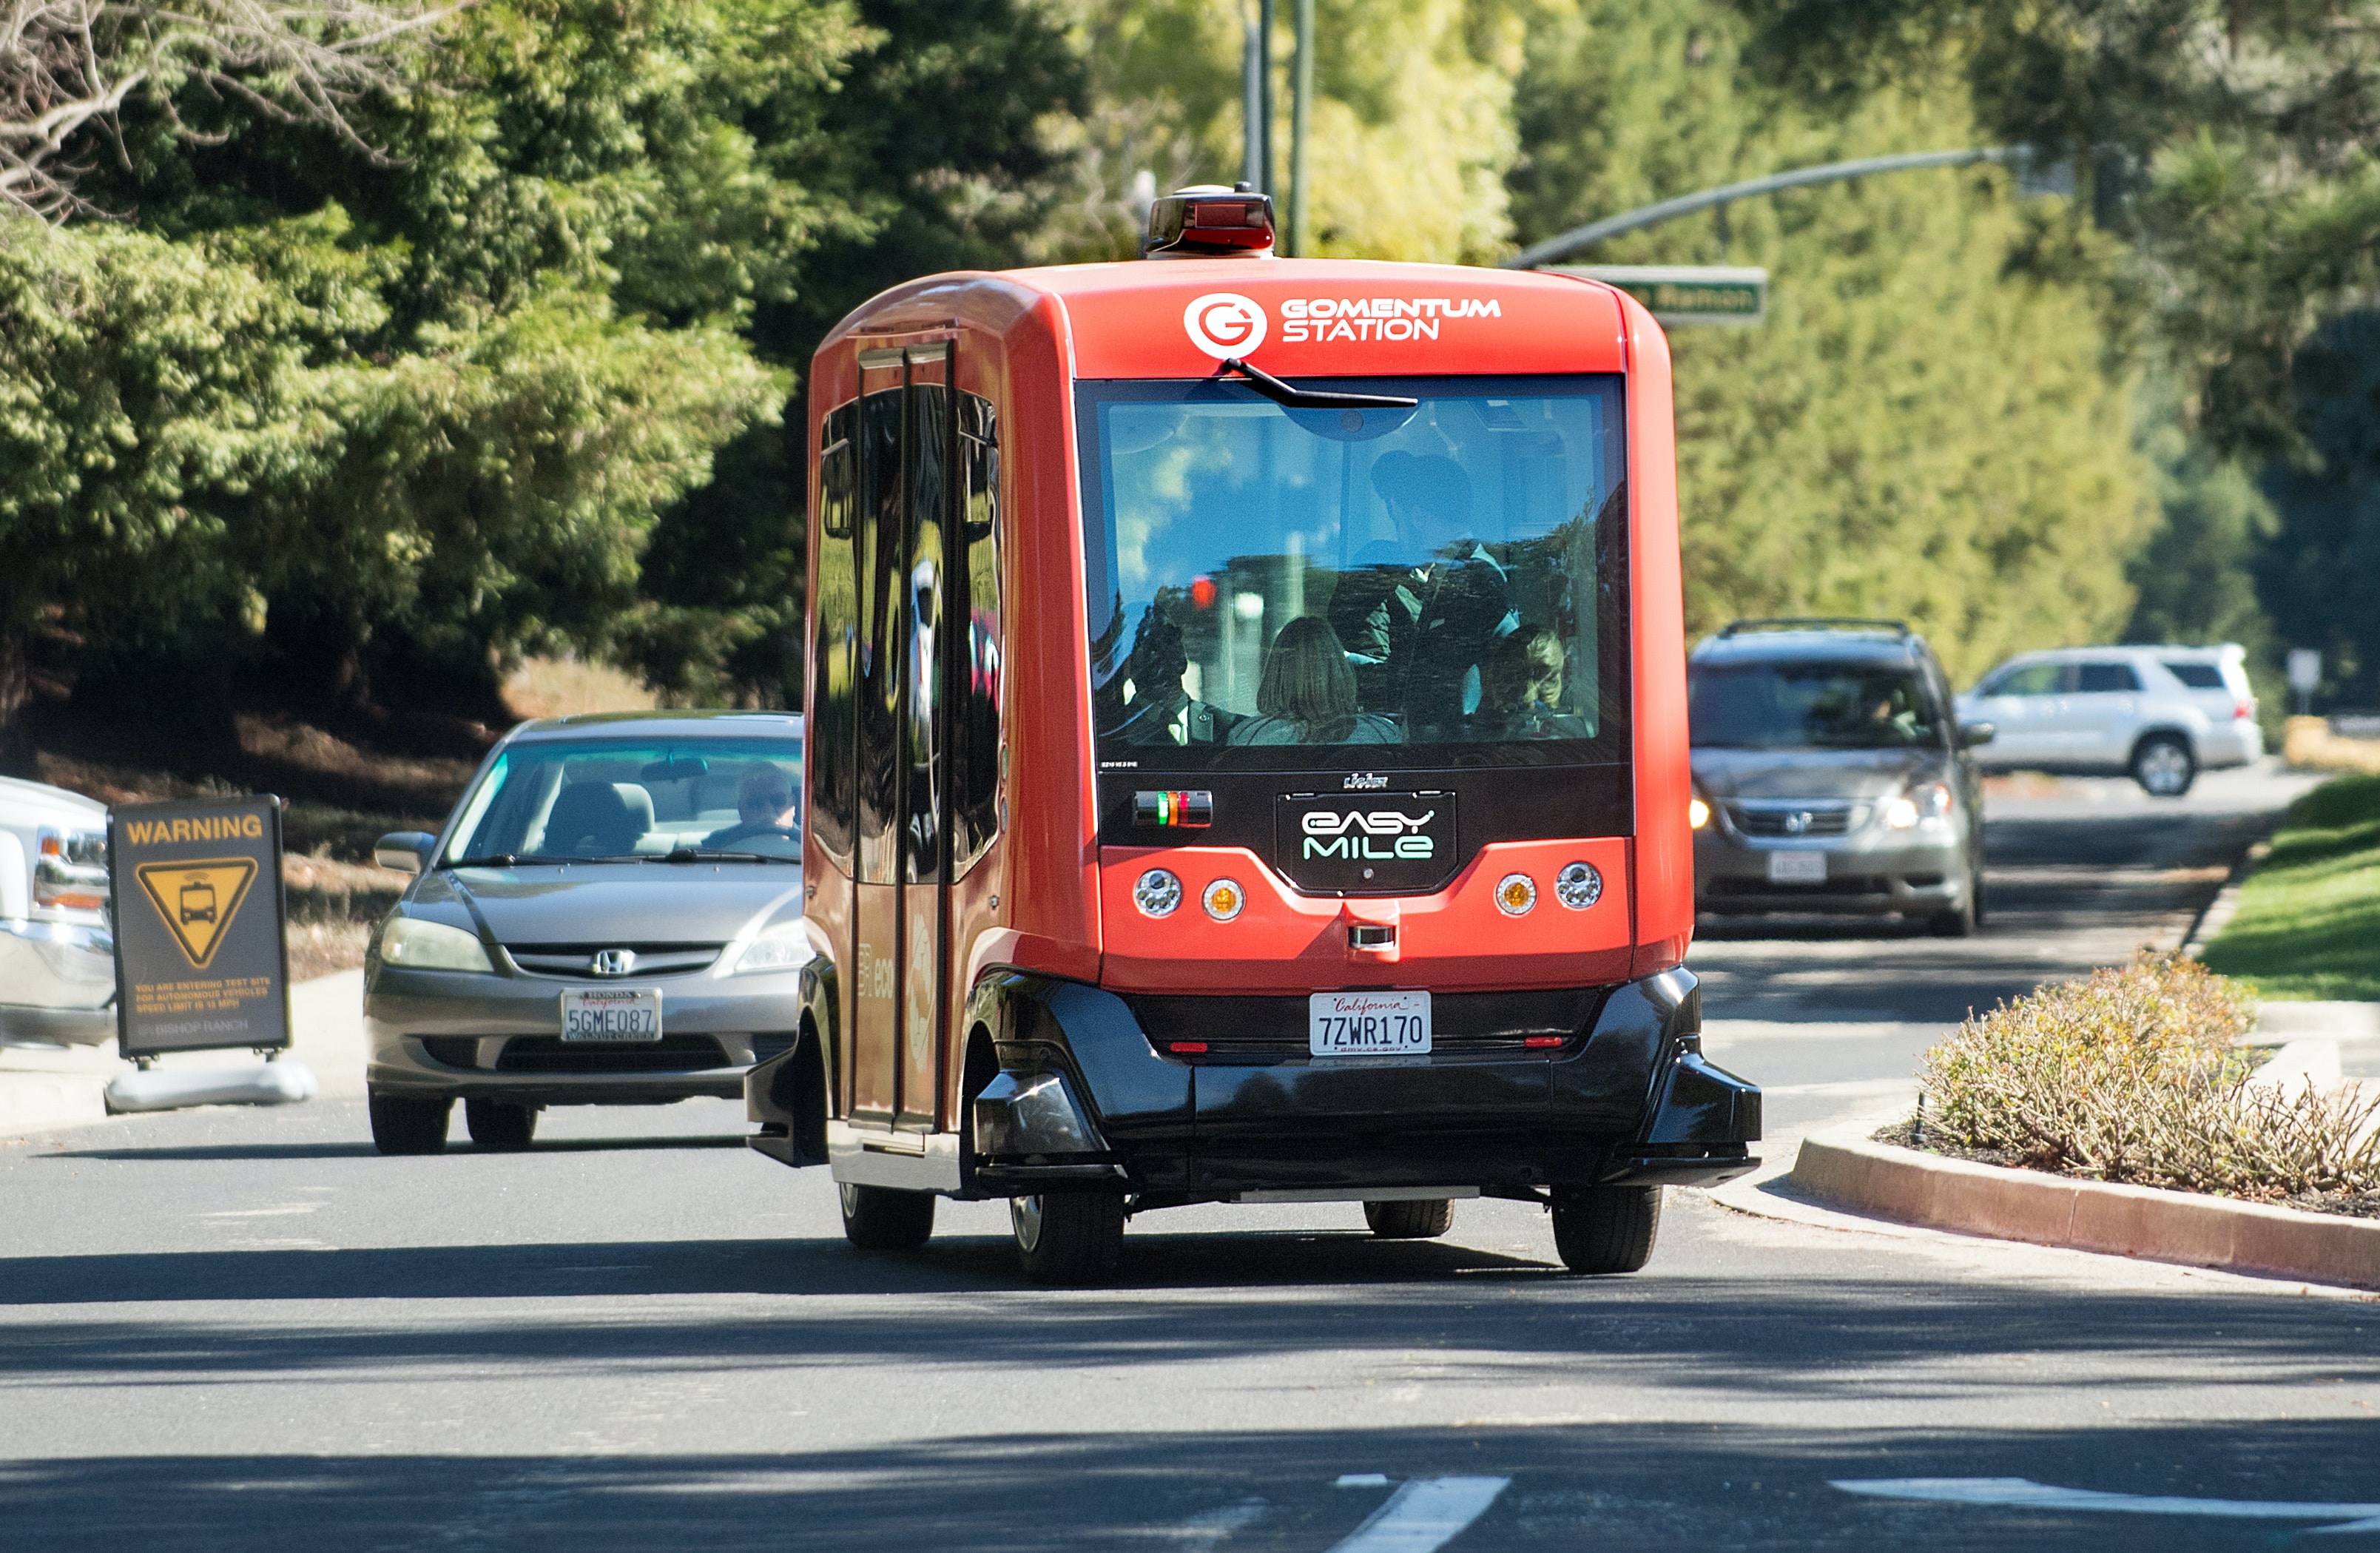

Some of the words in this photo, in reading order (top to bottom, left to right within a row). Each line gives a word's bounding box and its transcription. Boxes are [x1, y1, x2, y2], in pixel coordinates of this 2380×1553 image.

[1281, 298, 1502, 318] GOMENTUM
[1282, 318, 1440, 342] STATION
[127, 814, 262, 844] WARNING
[135, 984, 154, 992] YOU
[156, 983, 174, 991] ARE
[177, 980, 222, 991] ENTERING
[225, 978, 248, 987] TEST
[249, 977, 271, 986] SITE
[874, 958, 894, 1000] eco
[136, 994, 154, 1002] FOR
[157, 991, 220, 1001] AUTONOMOUS
[223, 987, 268, 998] VEHICLES
[582, 998, 636, 1009] California
[136, 1003, 166, 1013] SPEED
[167, 1001, 192, 1012] LIMIT
[1335, 998, 1408, 1015] California
[155, 1021, 201, 1034] BISHOP
[203, 1019, 249, 1031] RANCH
[569, 1009, 653, 1032] 5GME087
[1319, 1016, 1423, 1045] 7ZWR170
